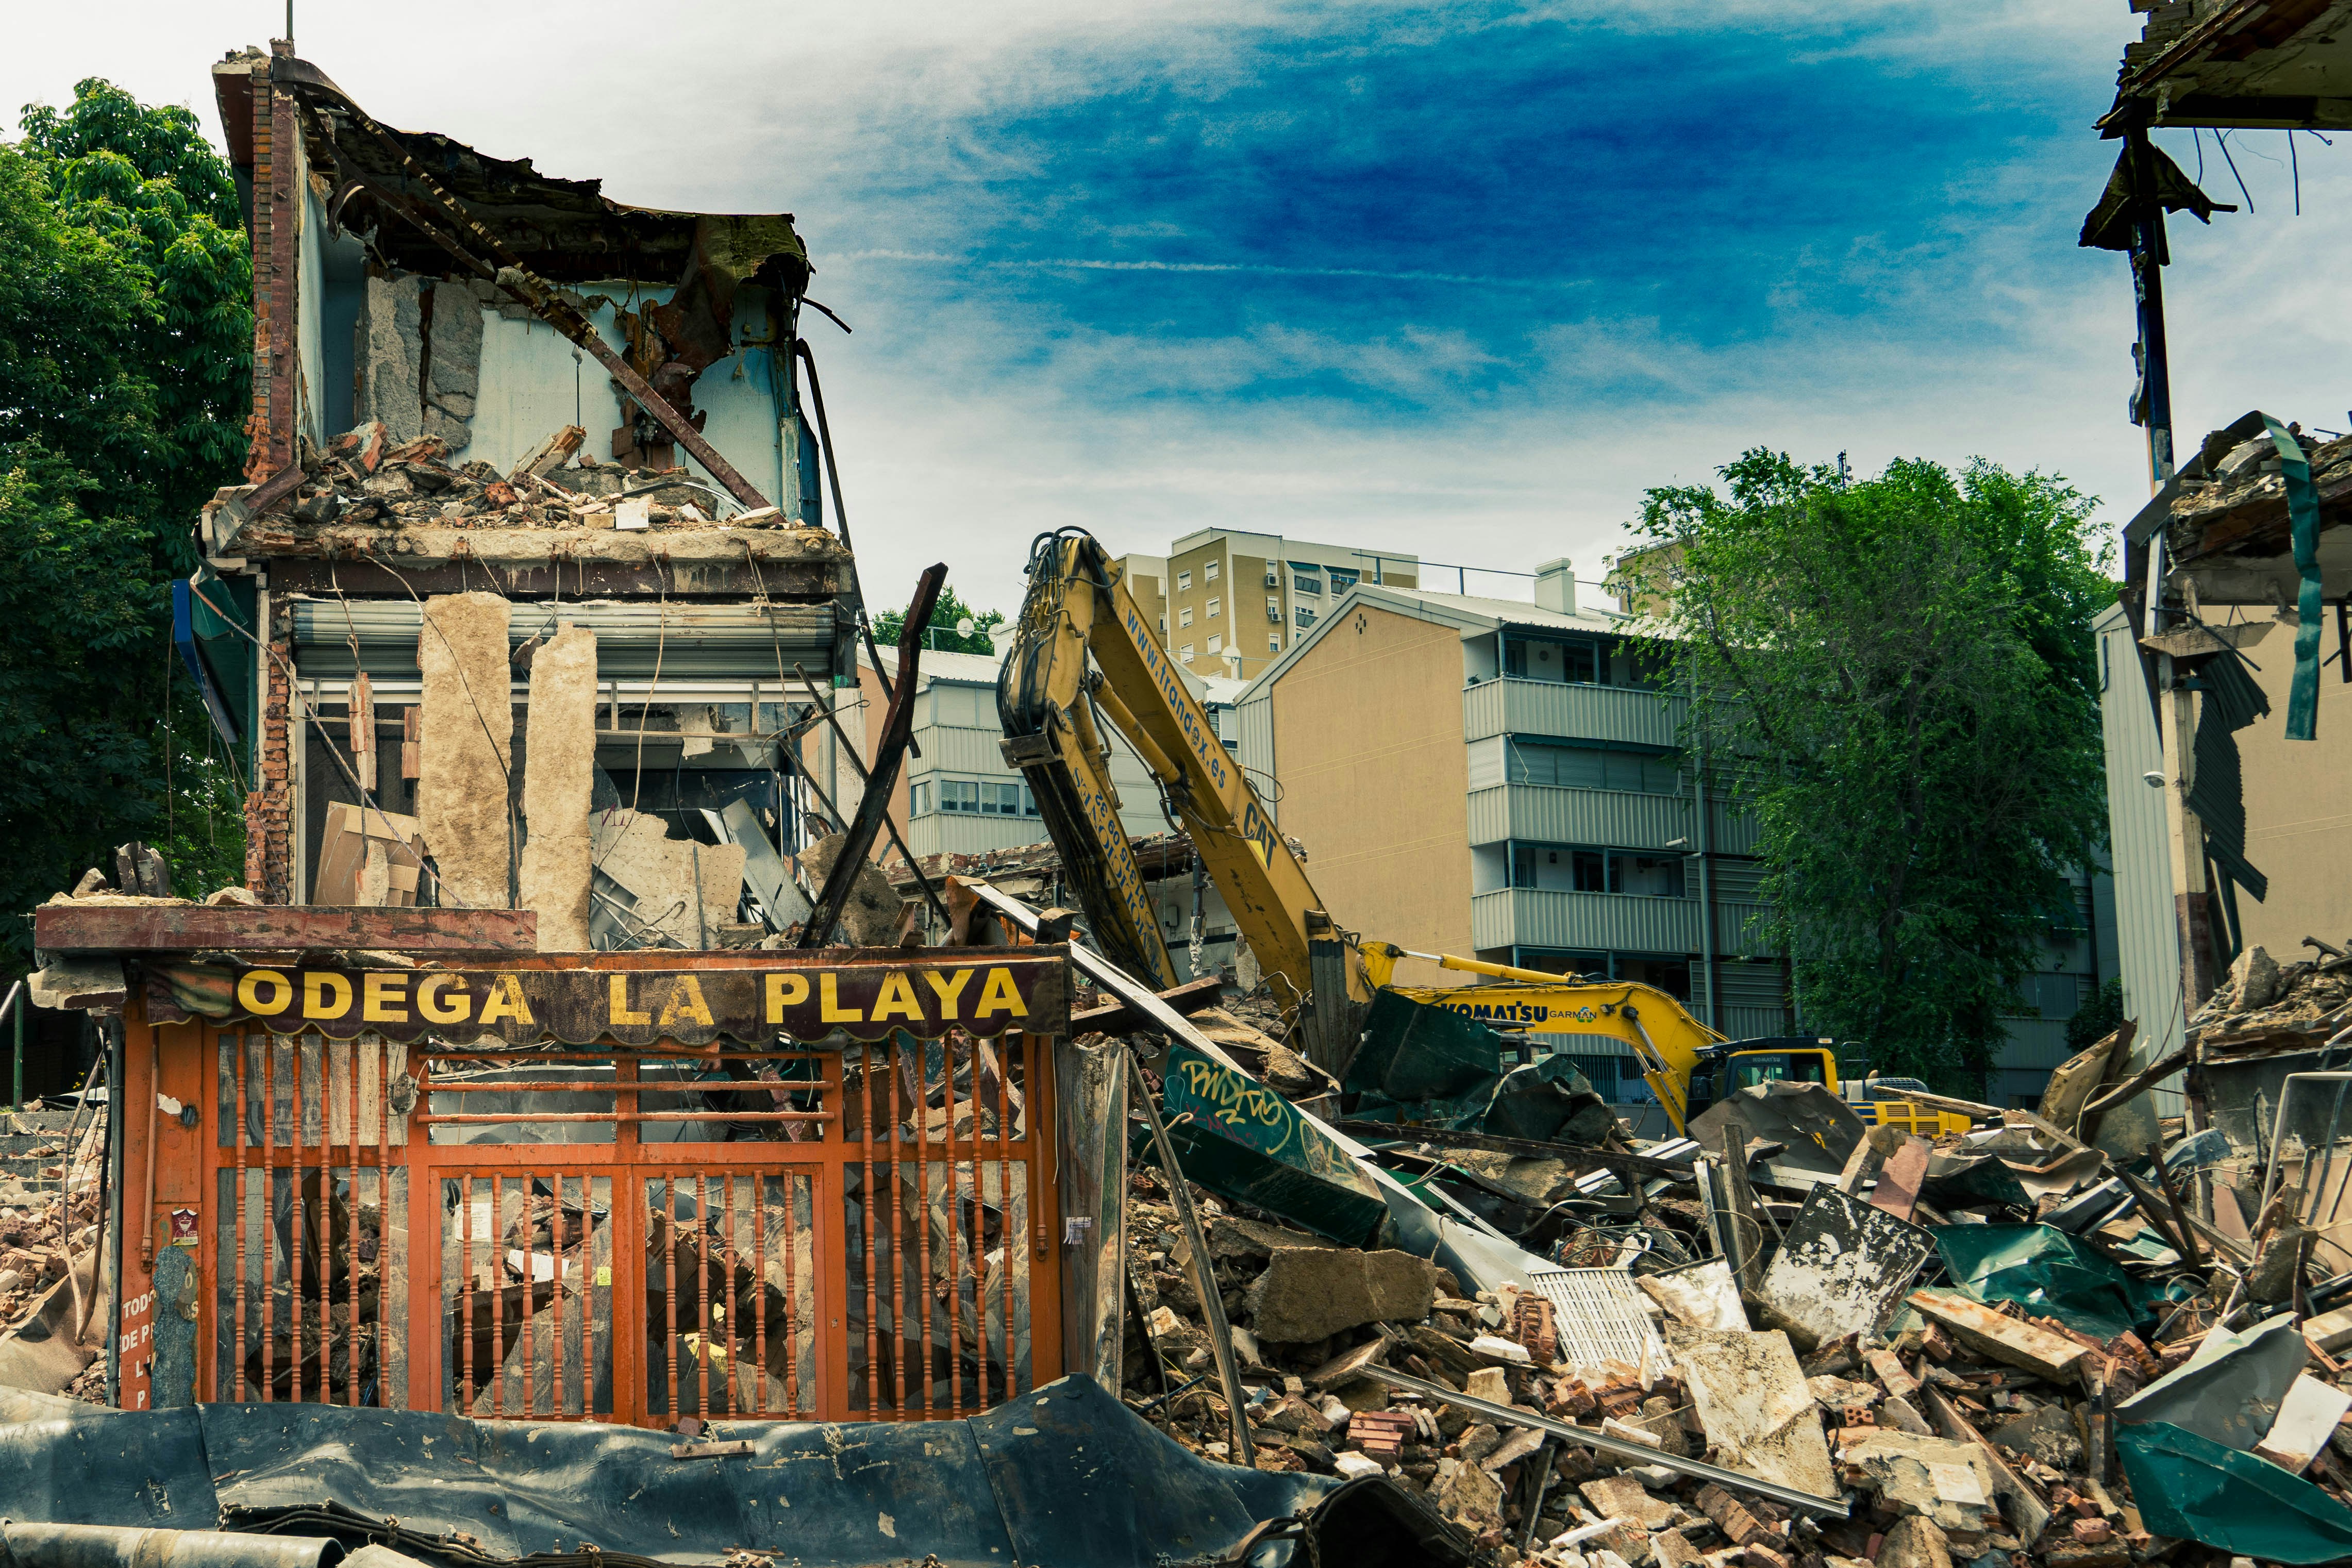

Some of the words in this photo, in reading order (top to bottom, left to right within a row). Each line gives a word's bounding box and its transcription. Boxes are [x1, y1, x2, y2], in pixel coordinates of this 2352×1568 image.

[1095, 791, 1108, 818] 32
[1108, 820, 1120, 845] 09
[1244, 802, 1277, 871] CAT
[237, 970, 534, 1024] ODEGA
[609, 975, 714, 1025] LA
[765, 968, 1029, 1024] PLAYA
[1549, 1010, 1597, 1019] GARMAN
[122, 1330, 138, 1353] DE
